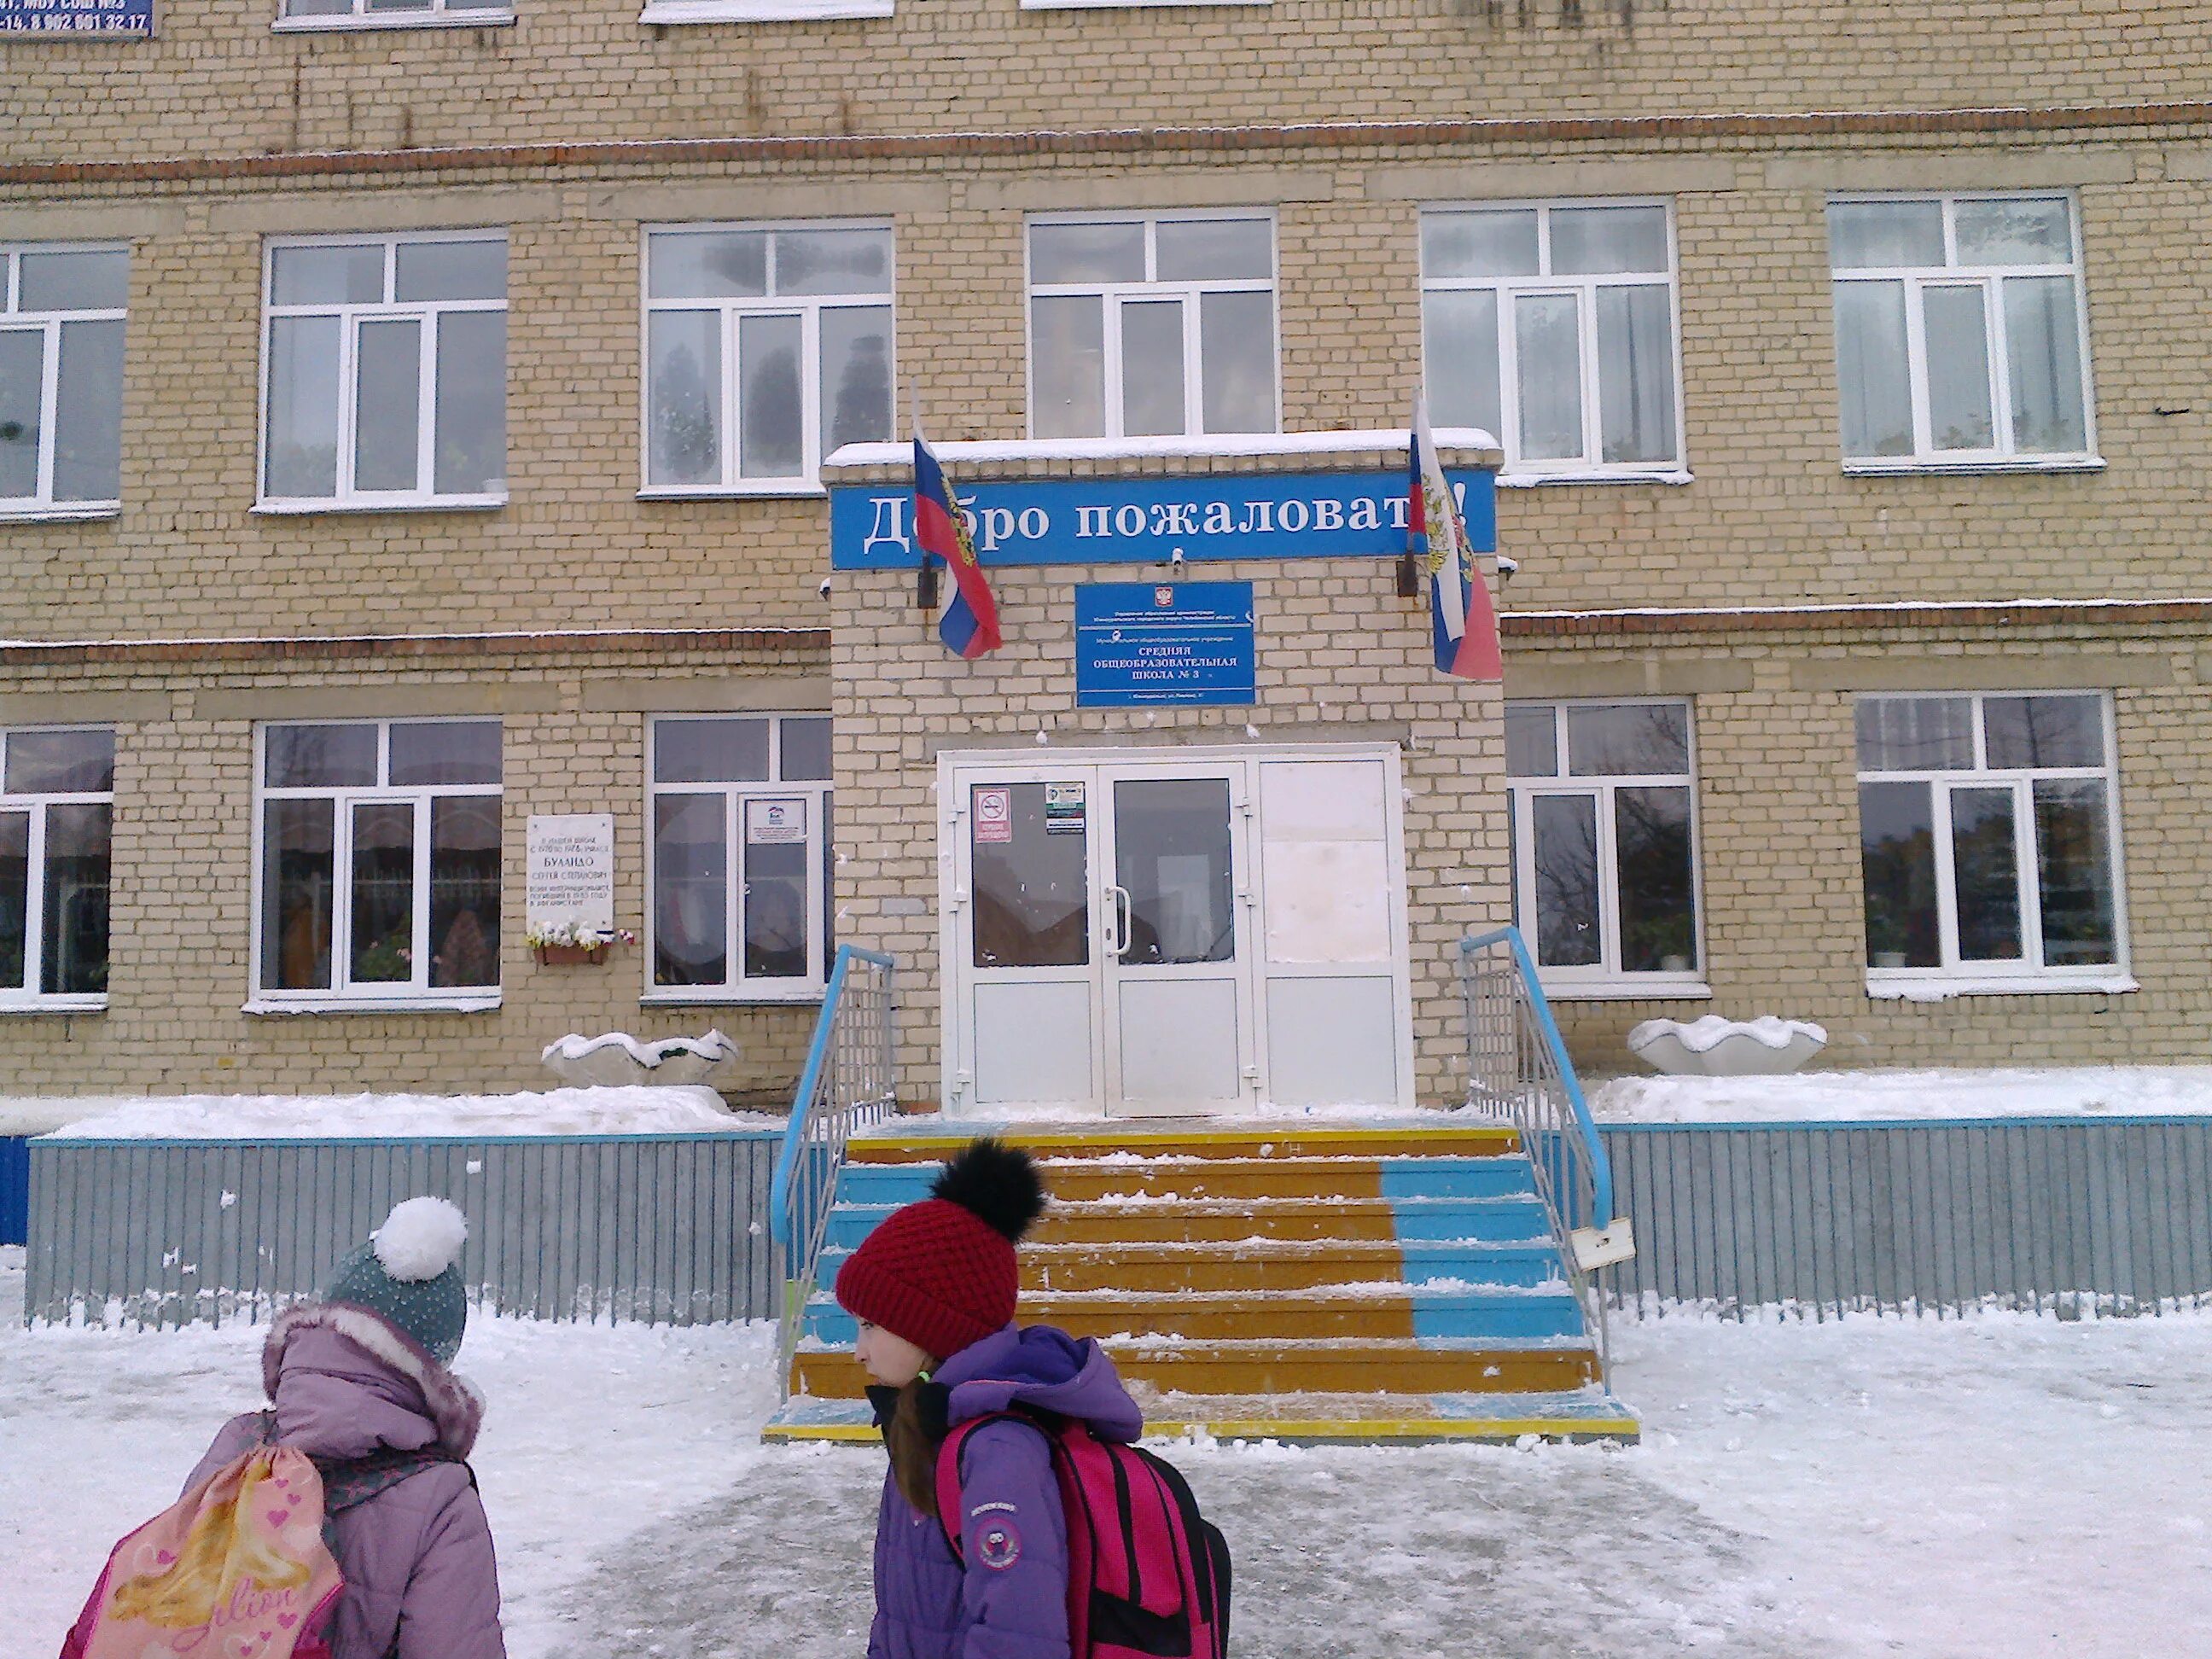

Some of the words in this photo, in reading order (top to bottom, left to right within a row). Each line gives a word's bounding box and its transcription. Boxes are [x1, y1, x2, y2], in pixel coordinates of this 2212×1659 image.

[106, 14, 125, 31] 32
[129, 14, 147, 30] 17
[863, 495, 1050, 555] Дбро
[1075, 481, 1467, 537] пожаловат!
[1138, 646, 1191, 656] СРЕДНЯЯ
[1093, 657, 1237, 669] ОБЩЕОБРАЗОВАТЕЛЬНАЯ
[1132, 670, 1174, 680] ШКОЛА
[1192, 670, 1200, 679] 3
[544, 857, 594, 867] БУЛАНДО
